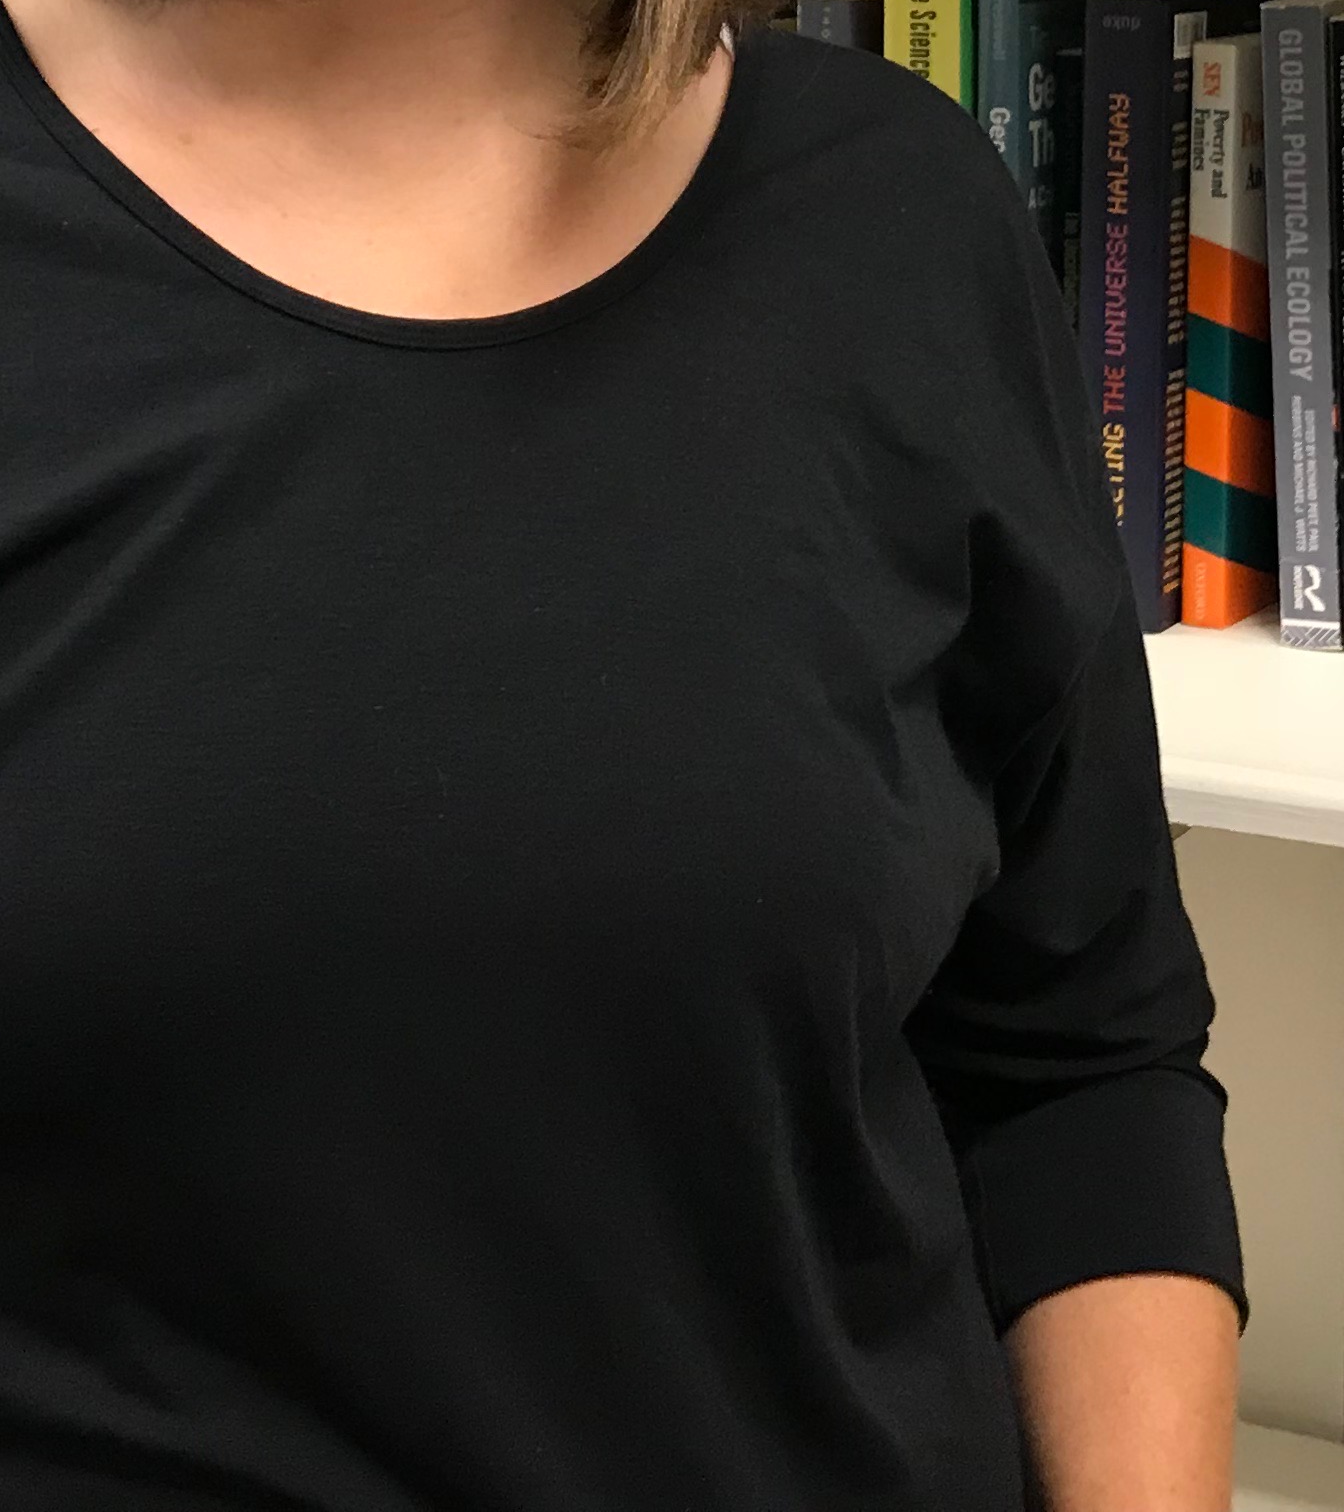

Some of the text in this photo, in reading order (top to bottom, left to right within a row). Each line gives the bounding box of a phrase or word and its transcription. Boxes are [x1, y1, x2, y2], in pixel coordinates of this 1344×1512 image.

[1202, 60, 1222, 97] SEN
[1193, 108, 1209, 172] Famines
[1209, 109, 1228, 199] Poverty and
[1278, 28, 1313, 382] GLOBAL POLITICAL ECOLOGY
[1103, 92, 1131, 414] THE UNIVERSE HALFWAY
